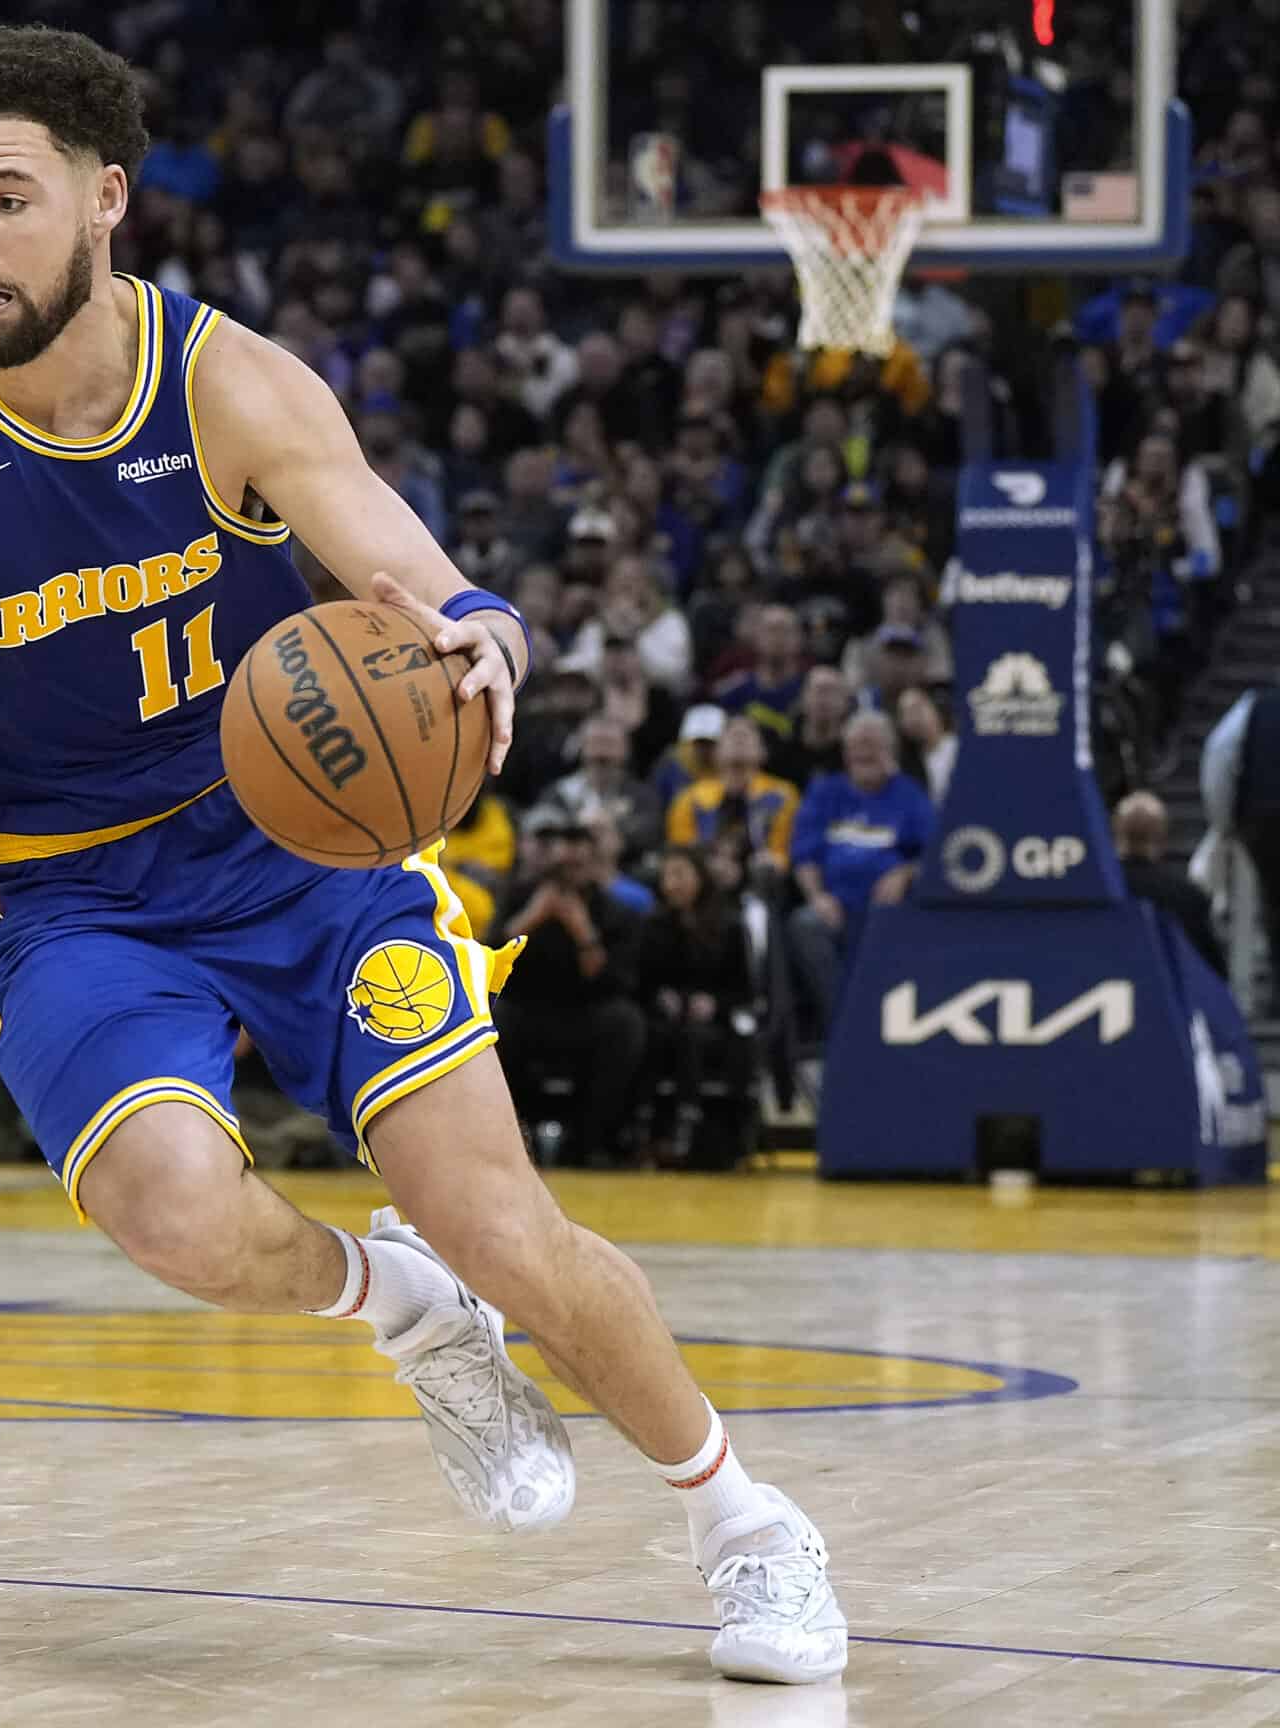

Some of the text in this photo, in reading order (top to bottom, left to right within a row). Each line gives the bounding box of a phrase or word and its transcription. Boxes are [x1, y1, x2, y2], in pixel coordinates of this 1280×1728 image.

[117, 452, 193, 483] Rakuten
[959, 571, 1071, 610] betway
[131, 602, 226, 723] 11
[272, 626, 369, 792] Wilson
[1012, 835, 1087, 879] GP
[881, 979, 1135, 1045] KIA
